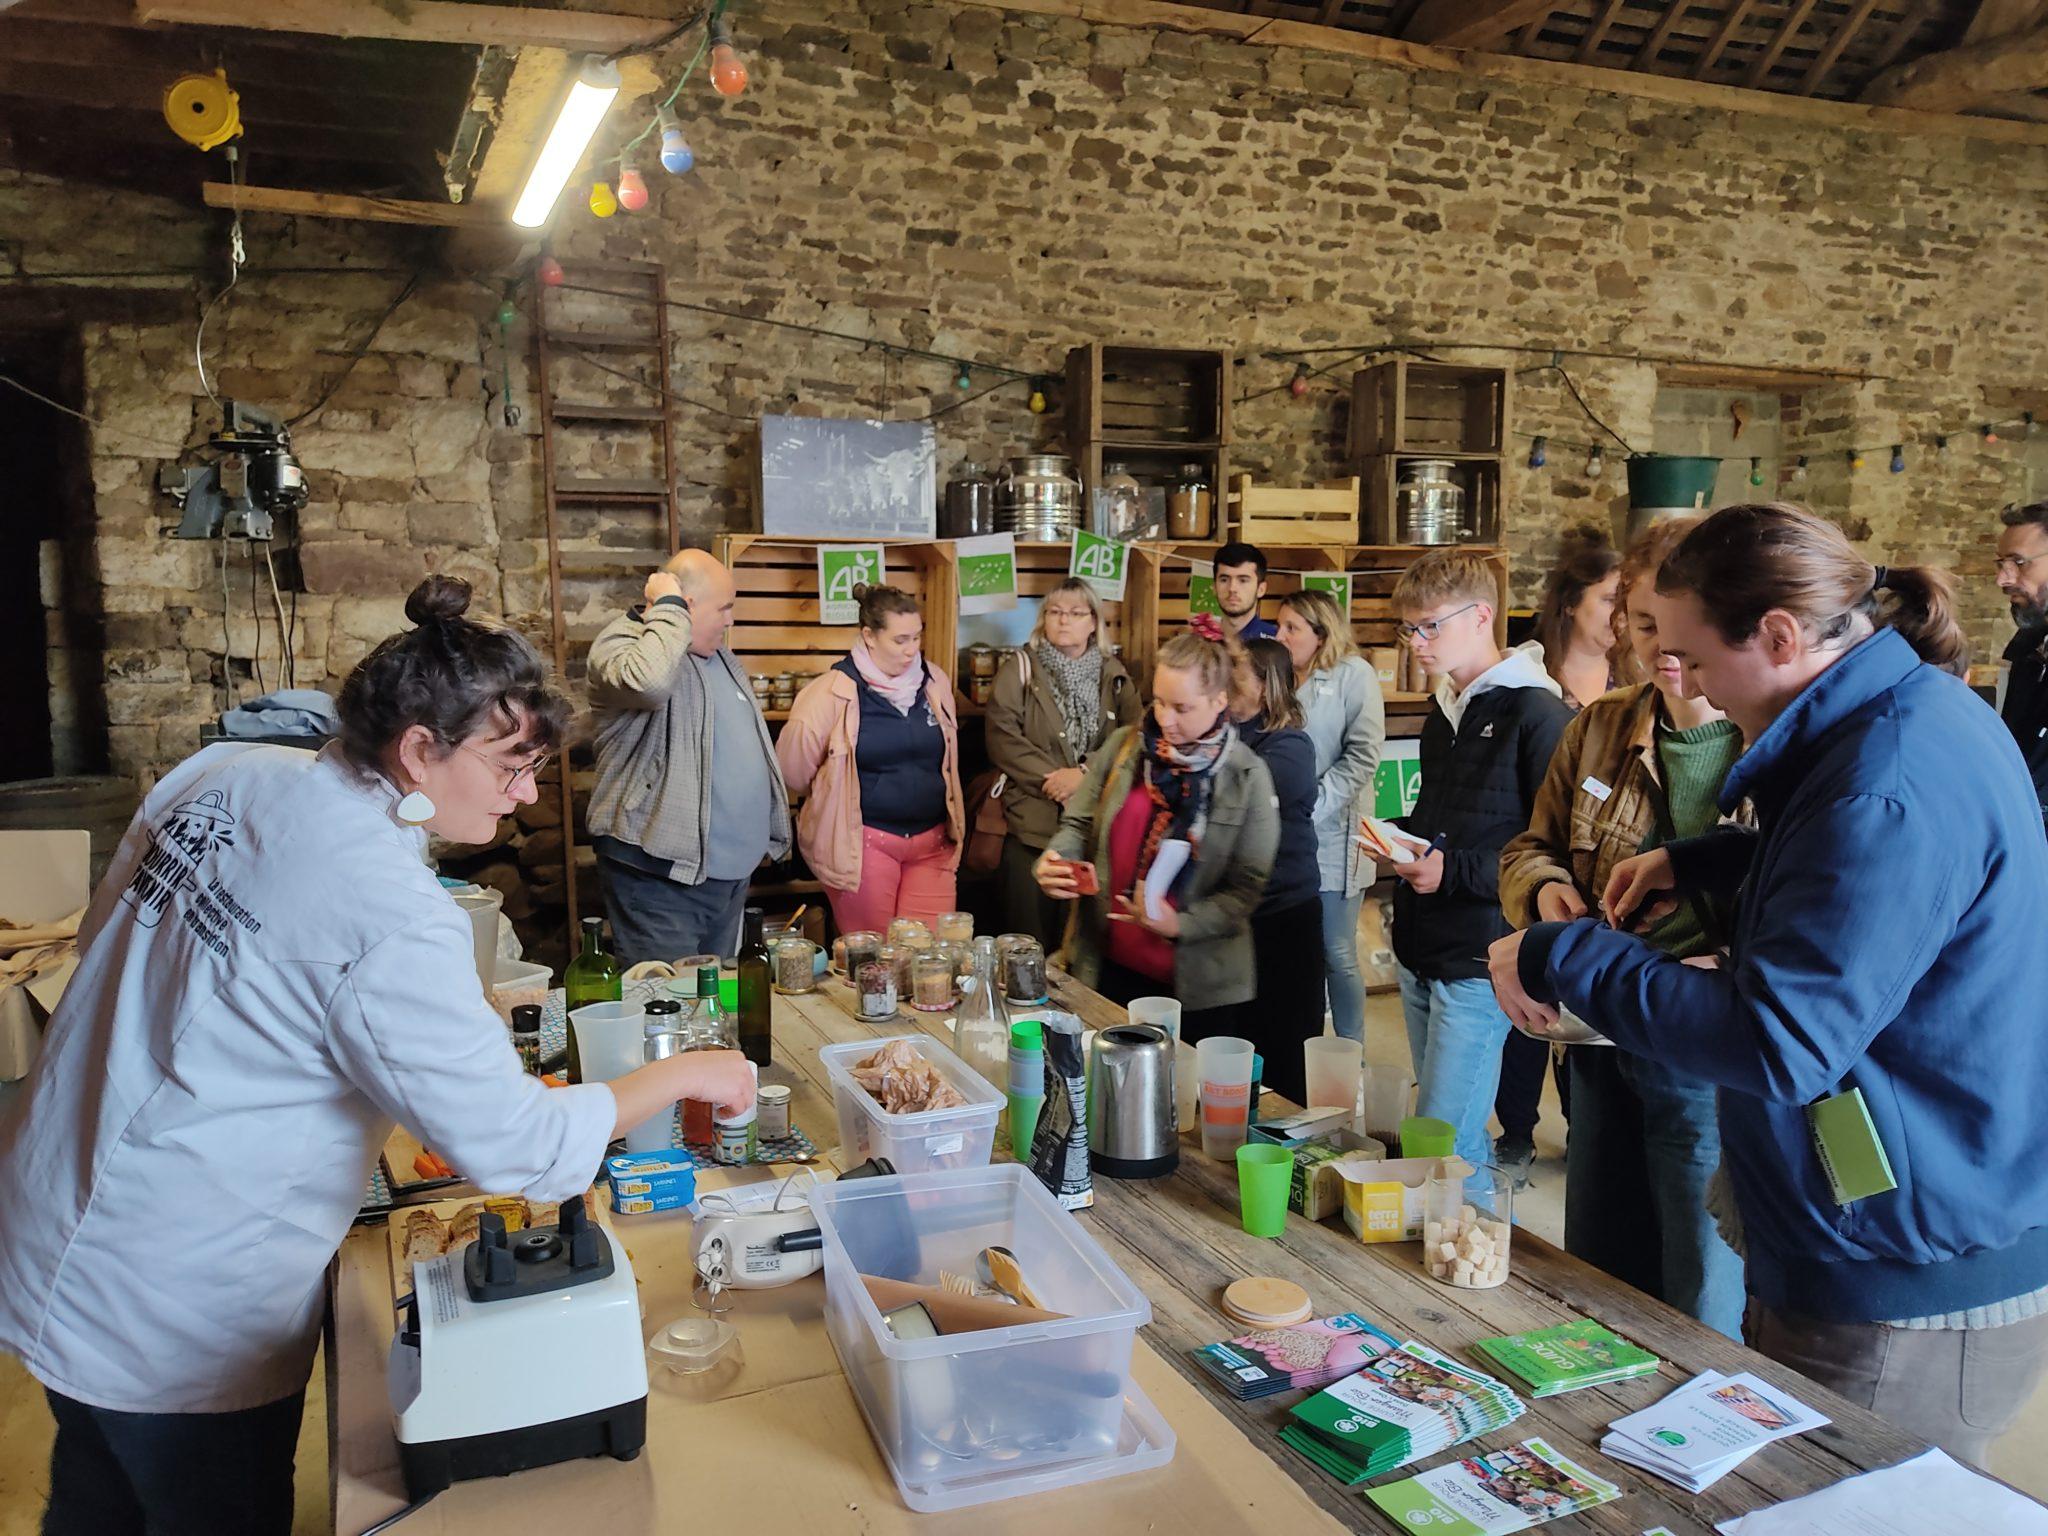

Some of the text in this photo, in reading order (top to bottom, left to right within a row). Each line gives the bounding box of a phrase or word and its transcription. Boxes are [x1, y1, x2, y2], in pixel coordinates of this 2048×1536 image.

[1076, 543, 1115, 577] AB
[208, 877, 262, 935] La restauration
[189, 916, 230, 958] transition
[1368, 1210, 1399, 1219] terra
[1368, 1220, 1399, 1230] etica
[1530, 1342, 1574, 1369] GUIDE
[1350, 1388, 1370, 1400] Bio
[1371, 1398, 1413, 1418] Manger
[1352, 1416, 1377, 1428] BIO
[1443, 1479, 1462, 1494] Bio
[1462, 1493, 1501, 1520] Manger
[1430, 1509, 1455, 1524] BIO
